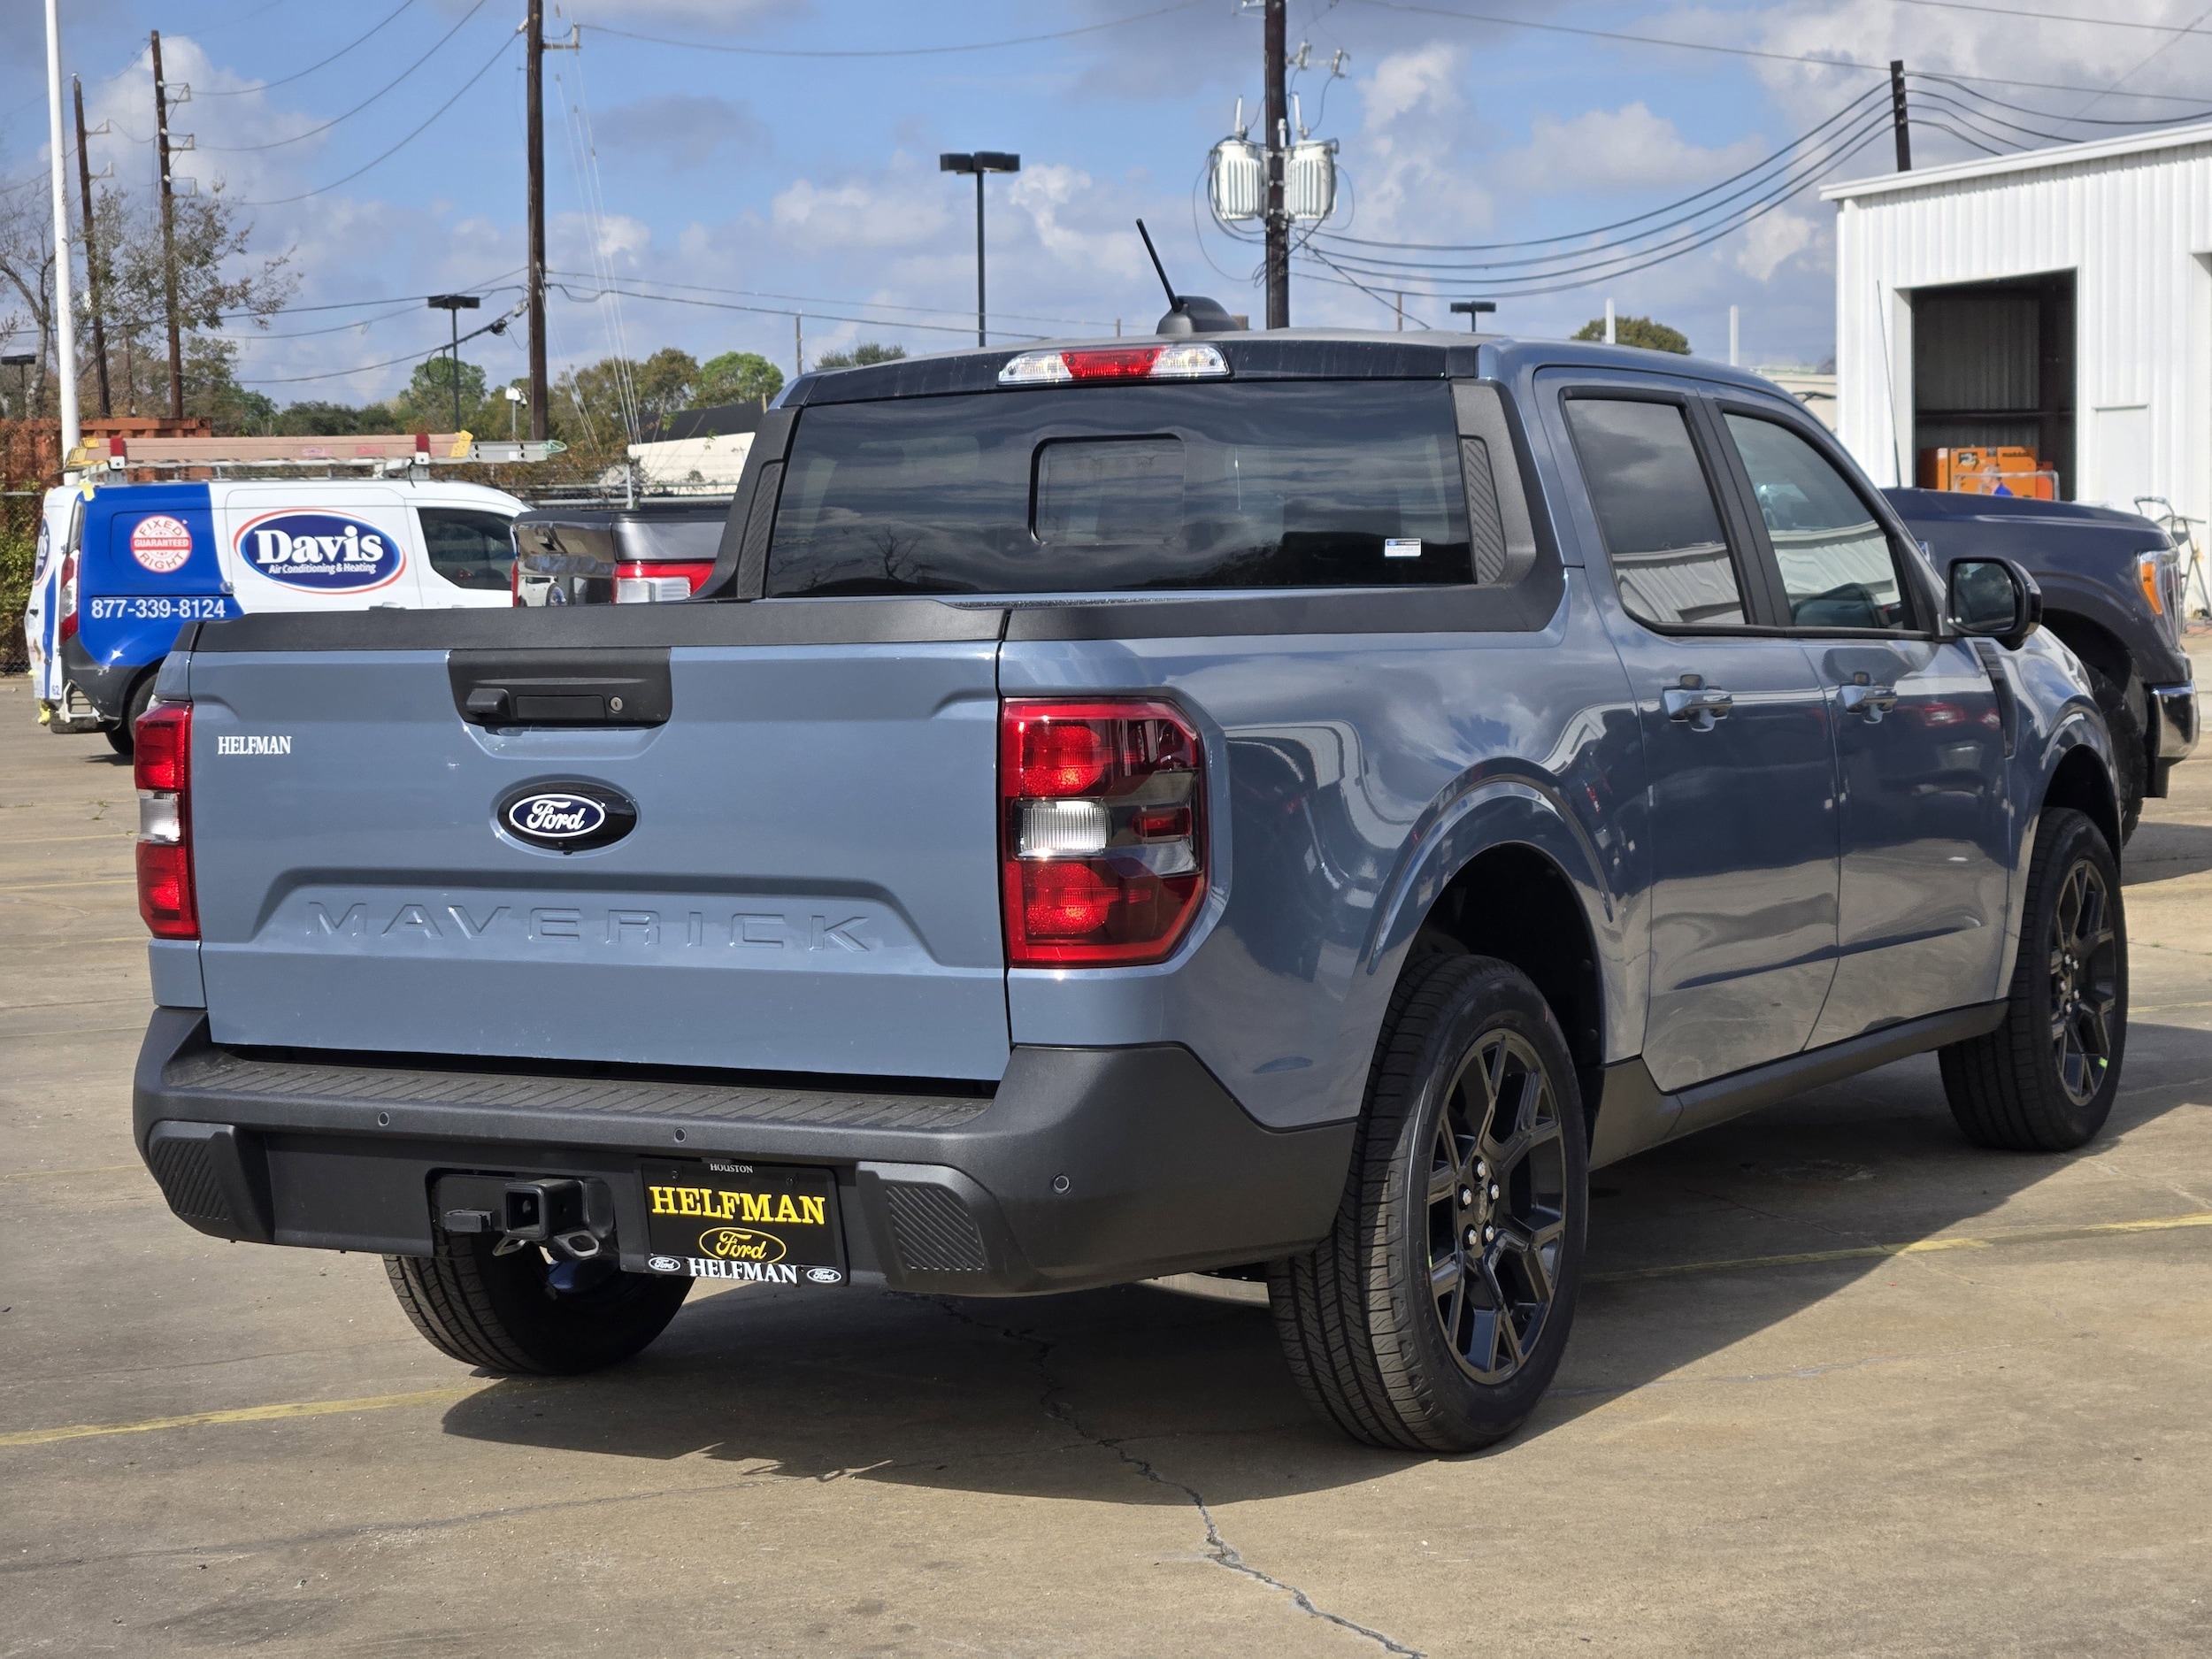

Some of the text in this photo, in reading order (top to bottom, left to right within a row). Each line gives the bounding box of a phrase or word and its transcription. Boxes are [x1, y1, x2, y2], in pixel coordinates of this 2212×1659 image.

[139, 519, 183, 536] FIXED
[134, 539, 189, 548] GUARANTEED
[254, 525, 384, 564] Davis
[140, 552, 184, 569] RIGHT
[268, 563, 376, 575] Air Conditioning & Heating
[91, 599, 227, 618] 877-339-8124
[218, 735, 292, 755] HELFMAN
[526, 799, 587, 830] Ford
[306, 901, 872, 952] MAVERICK
[710, 1163, 754, 1174] HOUSTON
[649, 1186, 826, 1225] HELFMAN
[716, 1231, 767, 1260] Ford
[654, 1258, 675, 1270] Ford
[687, 1257, 797, 1284] HELFMAN
[812, 1270, 835, 1281] Ford
